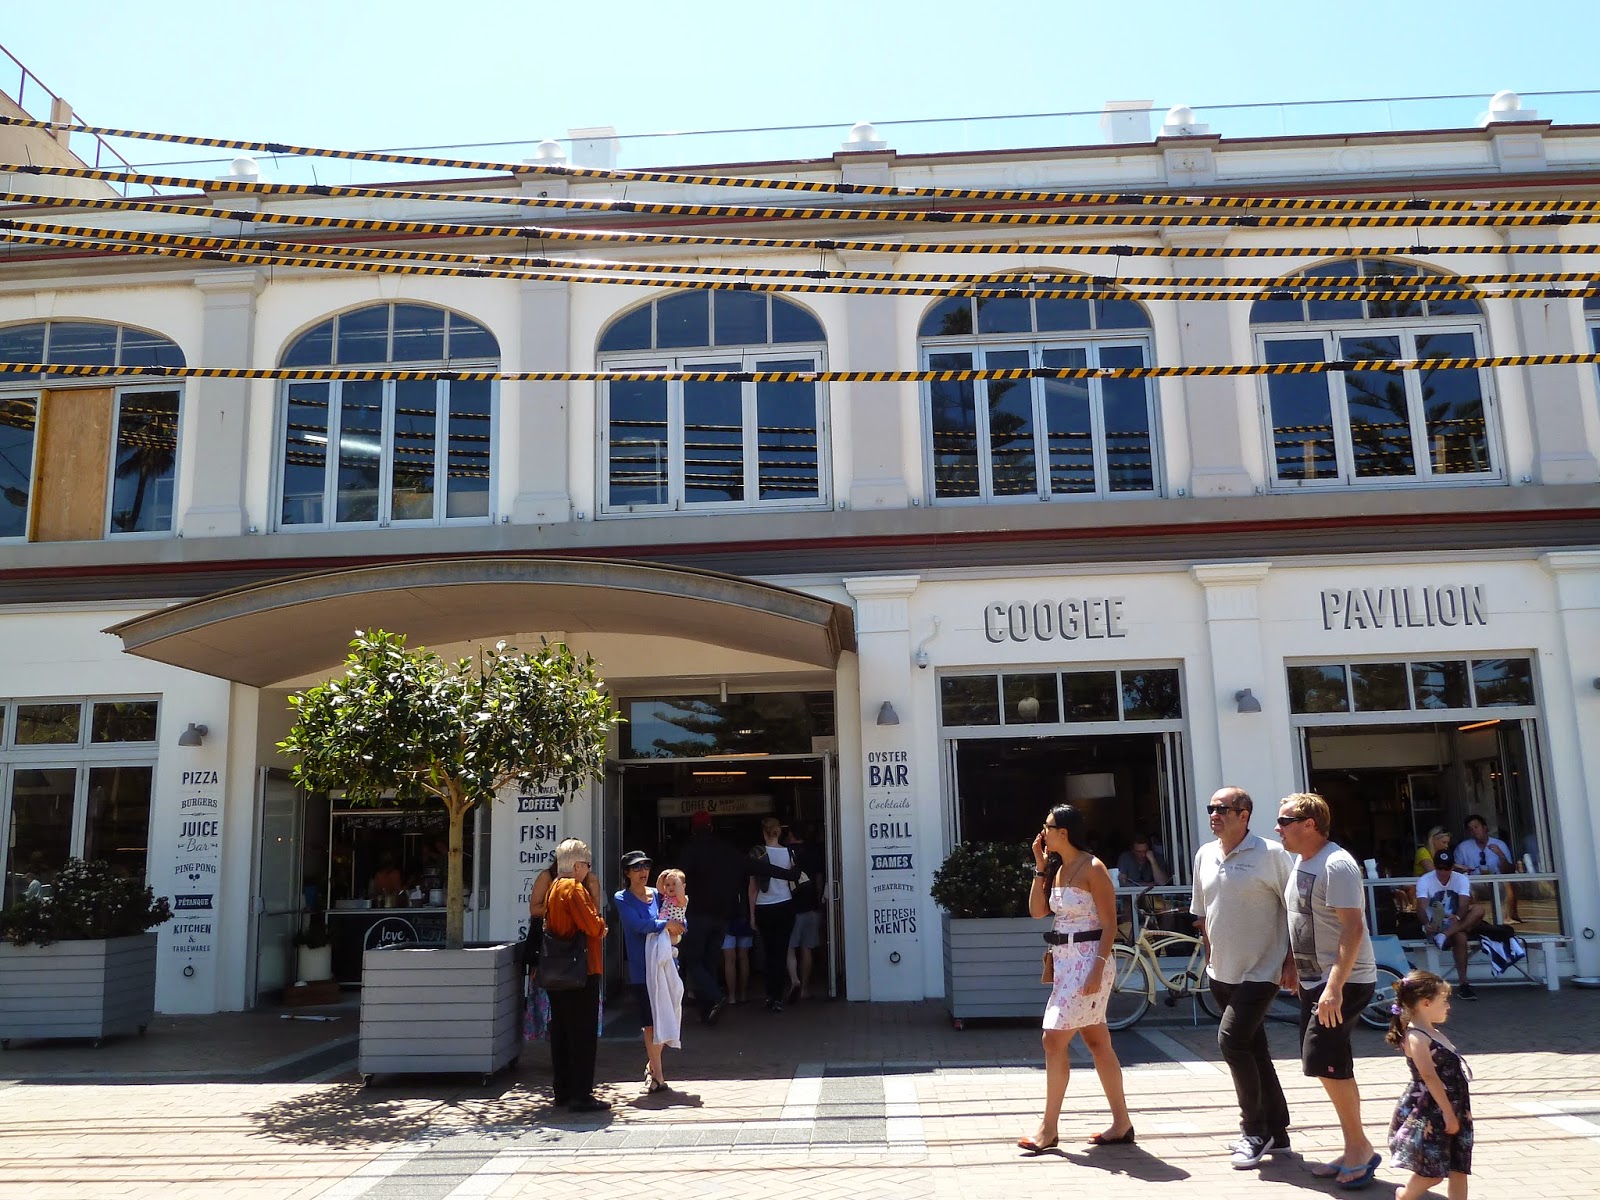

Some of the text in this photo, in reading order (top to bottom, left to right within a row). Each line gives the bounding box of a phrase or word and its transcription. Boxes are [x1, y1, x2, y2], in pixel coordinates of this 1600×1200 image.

[983, 583, 1489, 643] COOGEE PAVILION
[868, 751, 907, 763] OYSTER
[182, 771, 218, 785] PIZZA
[869, 765, 909, 787] BAR
[181, 798, 218, 809] BURGERS
[522, 799, 556, 811] COFFEE
[681, 799, 718, 813] COFFEE &
[869, 798, 910, 810] Cocktails
[179, 821, 218, 838] JUICE
[520, 825, 556, 844] FISH
[870, 822, 912, 839] GRILL
[186, 838, 210, 852] Bar
[535, 842, 543, 851] &
[520, 850, 556, 864] CHIPS
[875, 855, 909, 868] GAMES
[174, 863, 216, 875] PING PONG
[873, 883, 914, 893] THEATRETTE
[874, 908, 916, 925] REFRESH
[173, 924, 212, 934] KITCHEN
[875, 917, 917, 935] MENTS
[188, 935, 196, 943] &
[381, 926, 406, 941] love
[173, 945, 211, 953] TABLEWARES
